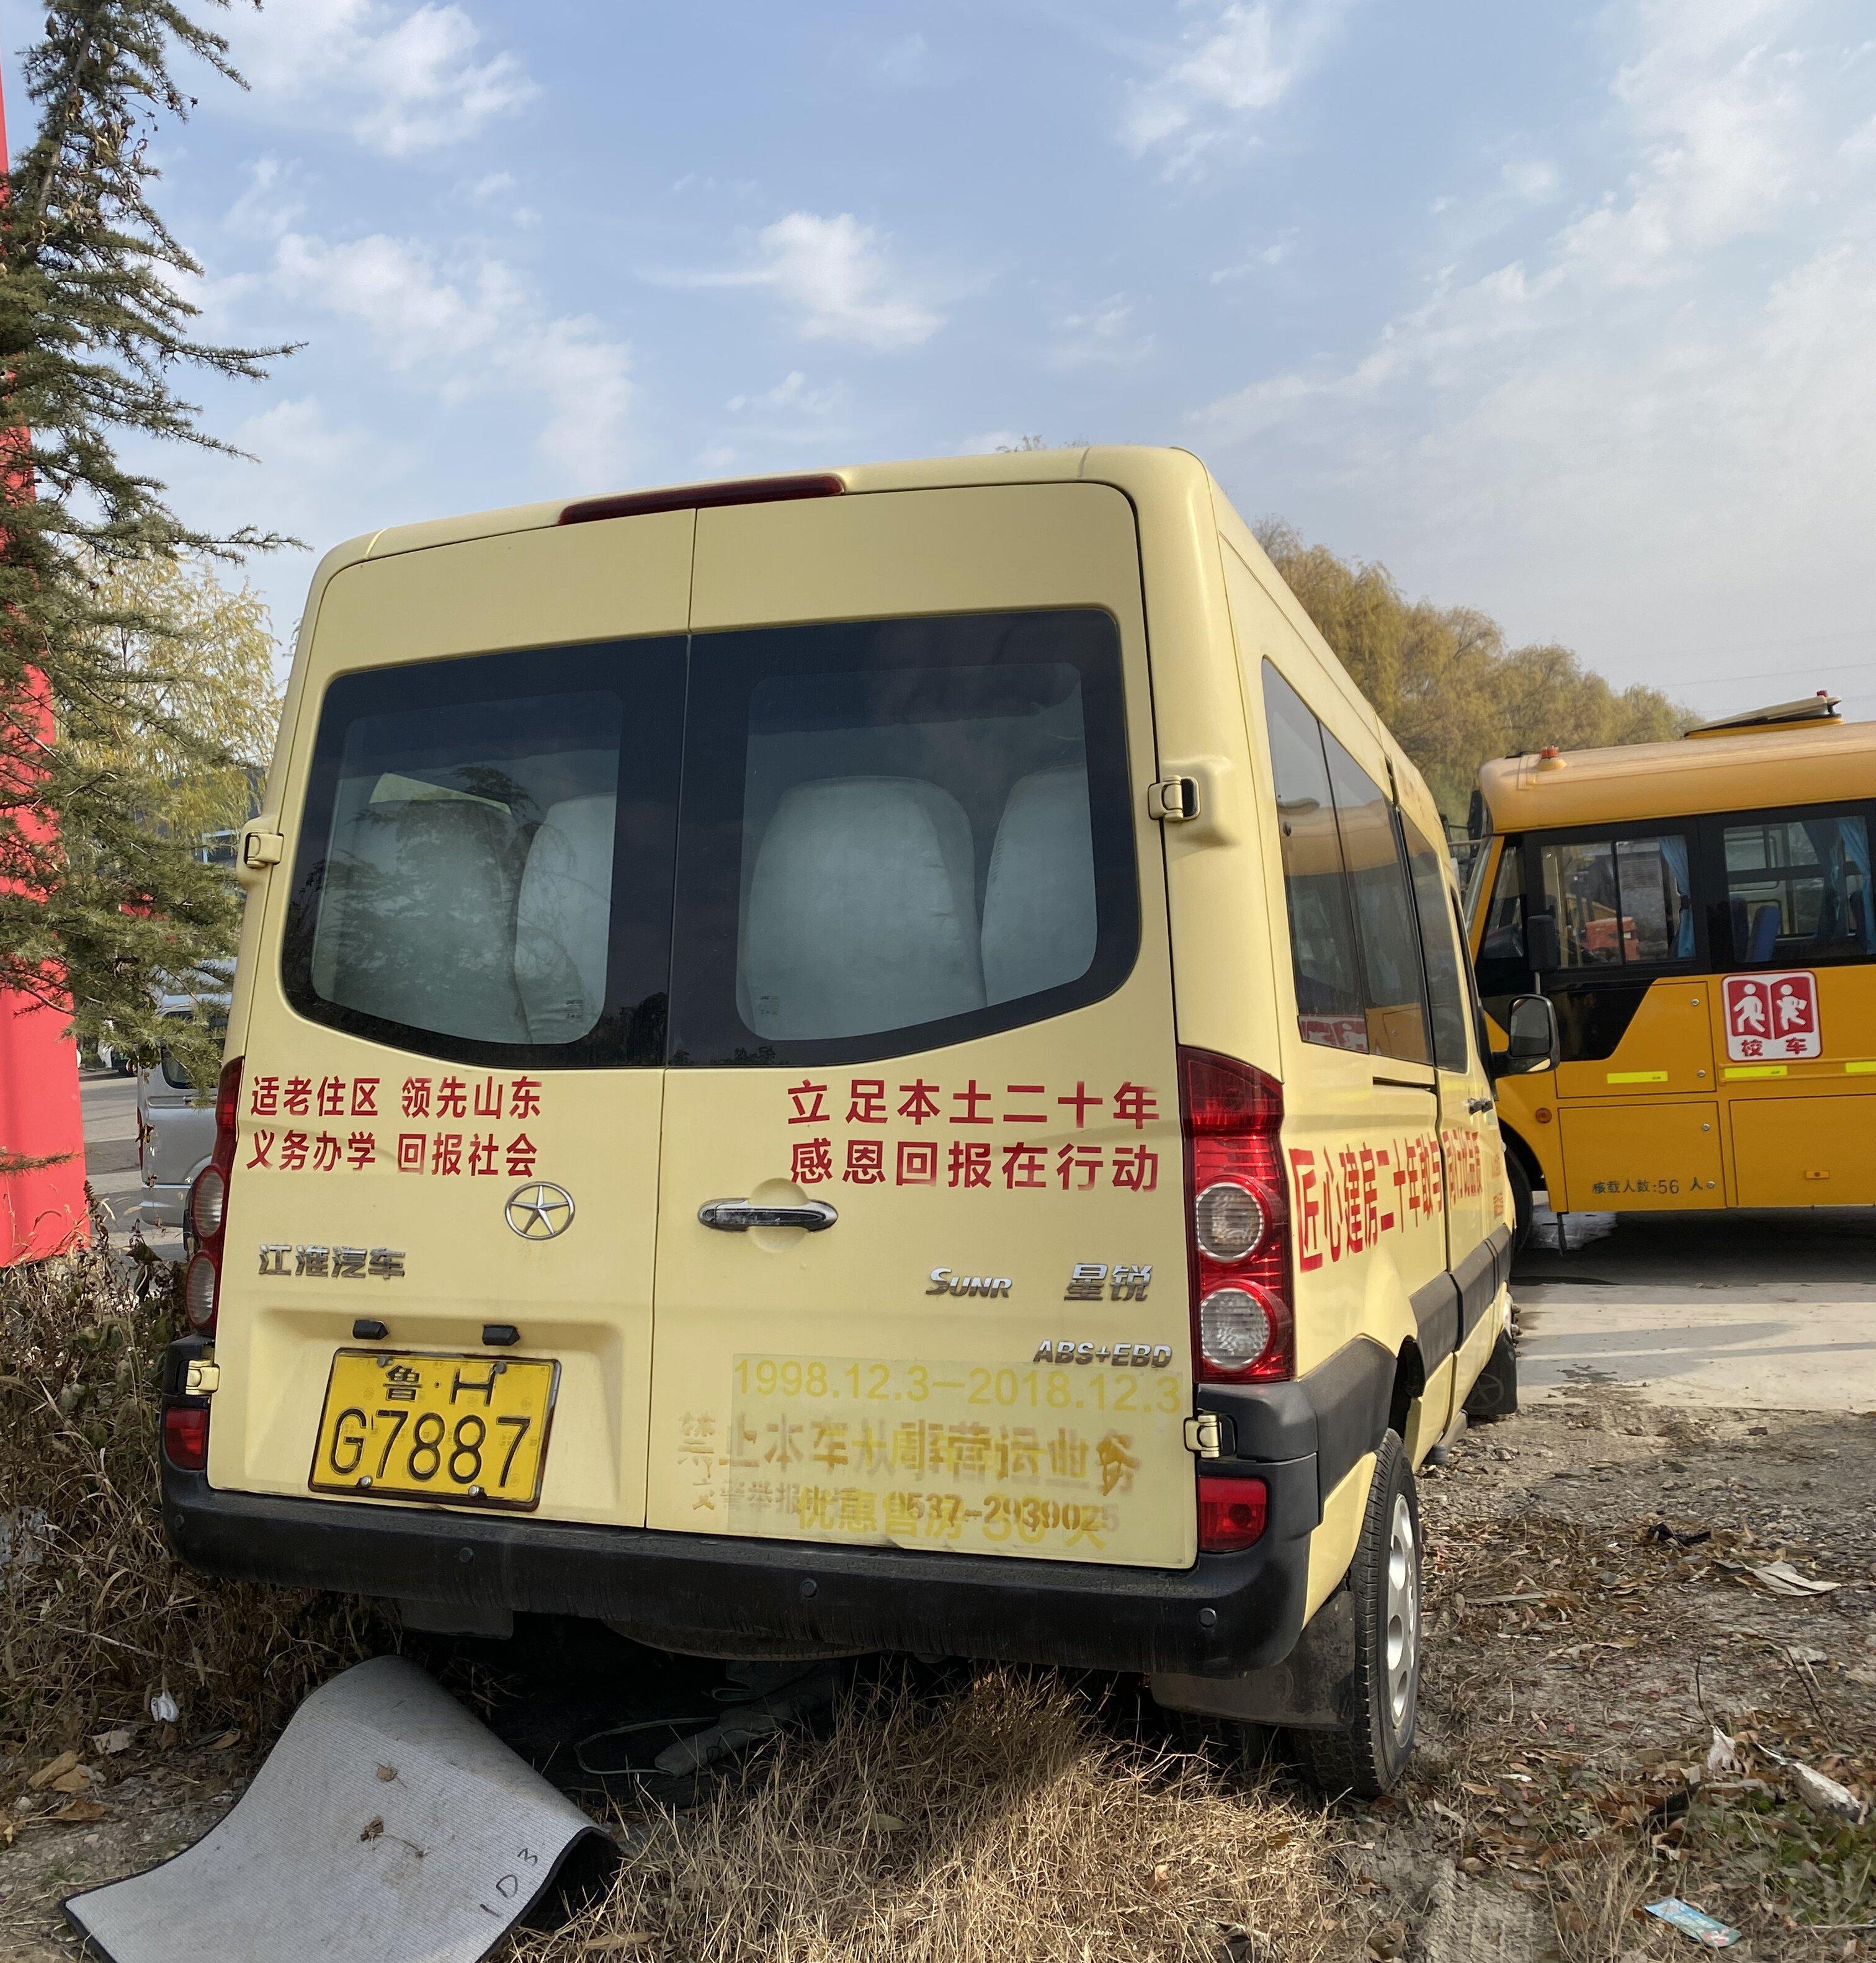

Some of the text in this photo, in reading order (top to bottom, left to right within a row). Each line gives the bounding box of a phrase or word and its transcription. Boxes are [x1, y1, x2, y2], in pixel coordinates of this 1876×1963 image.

[250, 1075, 542, 1119] 适老住区 领先山东
[787, 1078, 1160, 1129] 立足本土二十年
[246, 1129, 538, 1178] 义务办学 回报社会
[790, 1137, 1159, 1192] 感恩回报在行动
[258, 1243, 406, 1280] 江淮汽车
[1064, 1263, 1153, 1302] 星锐
[1032, 1340, 1172, 1369] ABS+EBD
[329, 1408, 532, 1489] G7887
